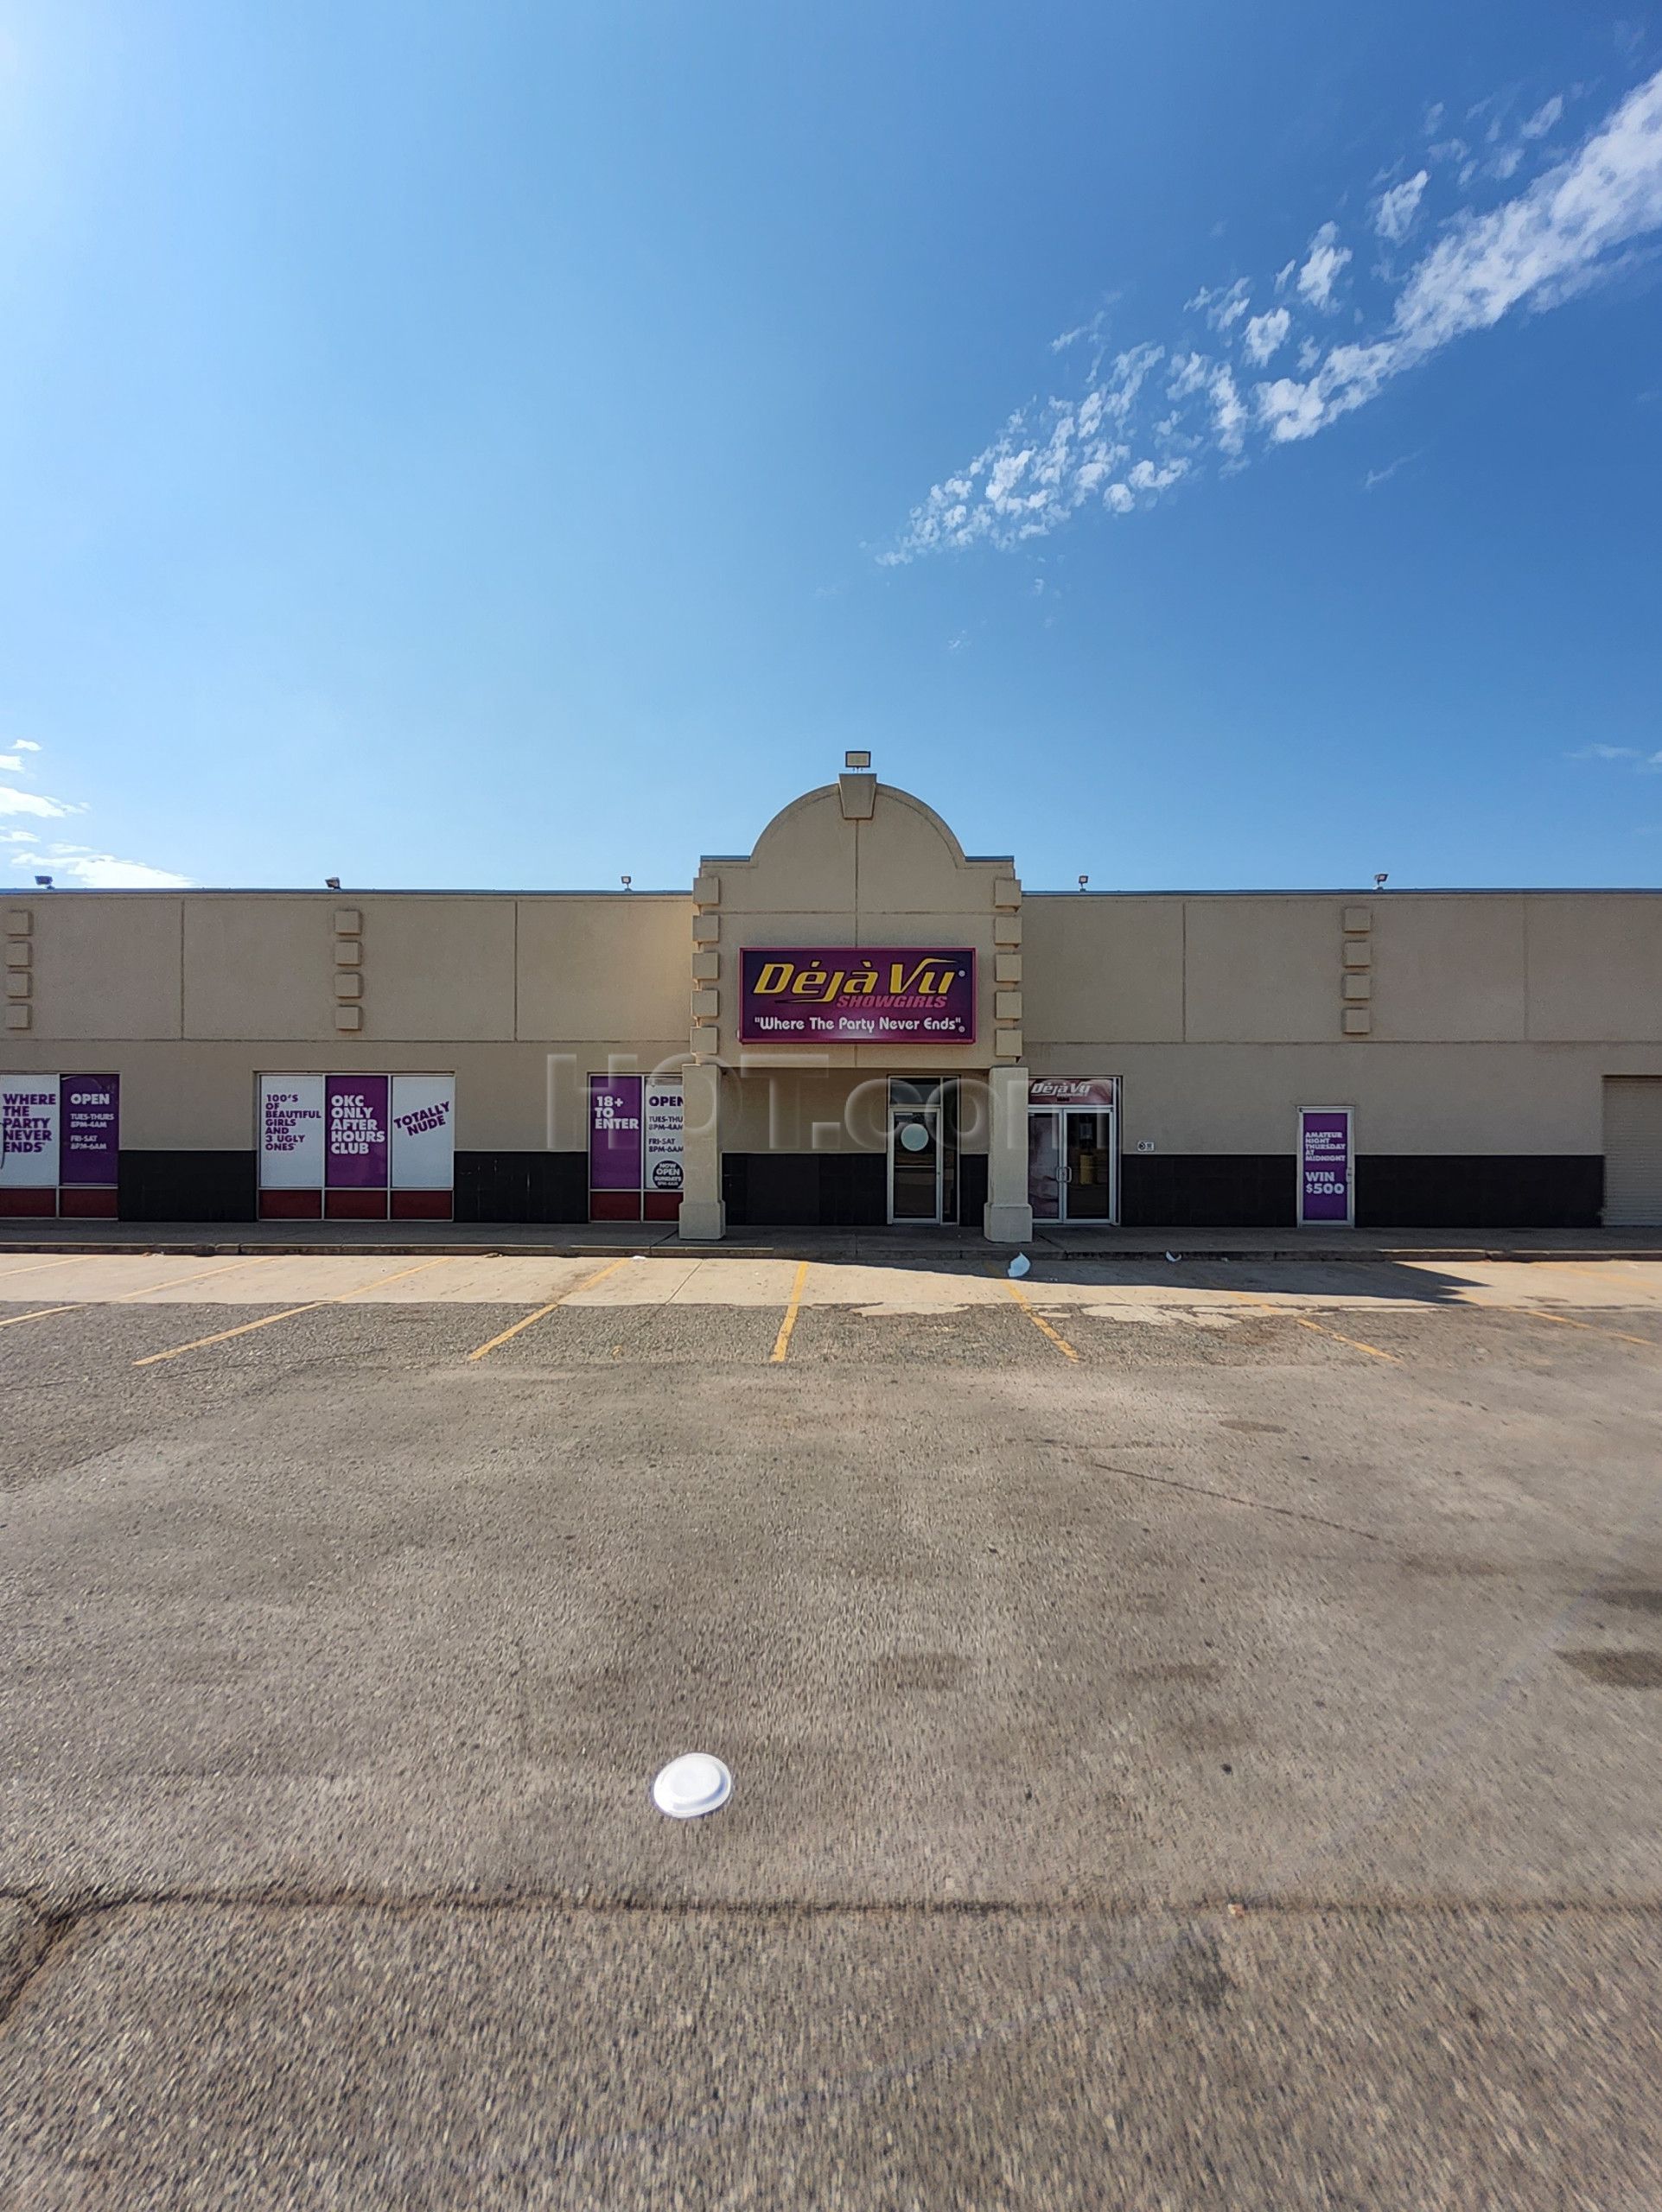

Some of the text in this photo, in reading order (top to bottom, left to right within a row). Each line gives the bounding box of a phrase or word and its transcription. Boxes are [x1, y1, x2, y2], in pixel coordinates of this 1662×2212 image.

[836, 995, 948, 1008] SHOWGIRLS
[810, 1017, 835, 1030] The
[838, 1017, 875, 1033] Party
[879, 1018, 920, 1030] Never
[3, 1093, 56, 1105] WHERE
[70, 1093, 110, 1105] OPEN
[266, 1094, 298, 1103] 100'S
[331, 1095, 365, 1107] OKC
[596, 1096, 623, 1107] 18+
[3, 1105, 29, 1116] THE
[265, 1110, 322, 1119] BEAUTIFUL
[331, 1107, 373, 1118] ONLY
[393, 1101, 450, 1129] TOTALLY
[595, 1107, 614, 1118] TO
[3, 1117, 51, 1128] PARTY
[265, 1118, 296, 1127] GIRLS
[330, 1119, 378, 1131] AFTER
[406, 1115, 446, 1136] NUDE
[595, 1118, 639, 1129] ENTER
[3, 1129, 52, 1141] NEVER
[331, 1130, 385, 1142] HOURS
[3, 1141, 43, 1153] ENDS
[265, 1142, 295, 1151] ONES
[331, 1142, 369, 1154] CLUB
[1305, 1172, 1334, 1182] WIN
[1306, 1183, 1345, 1194] $500
